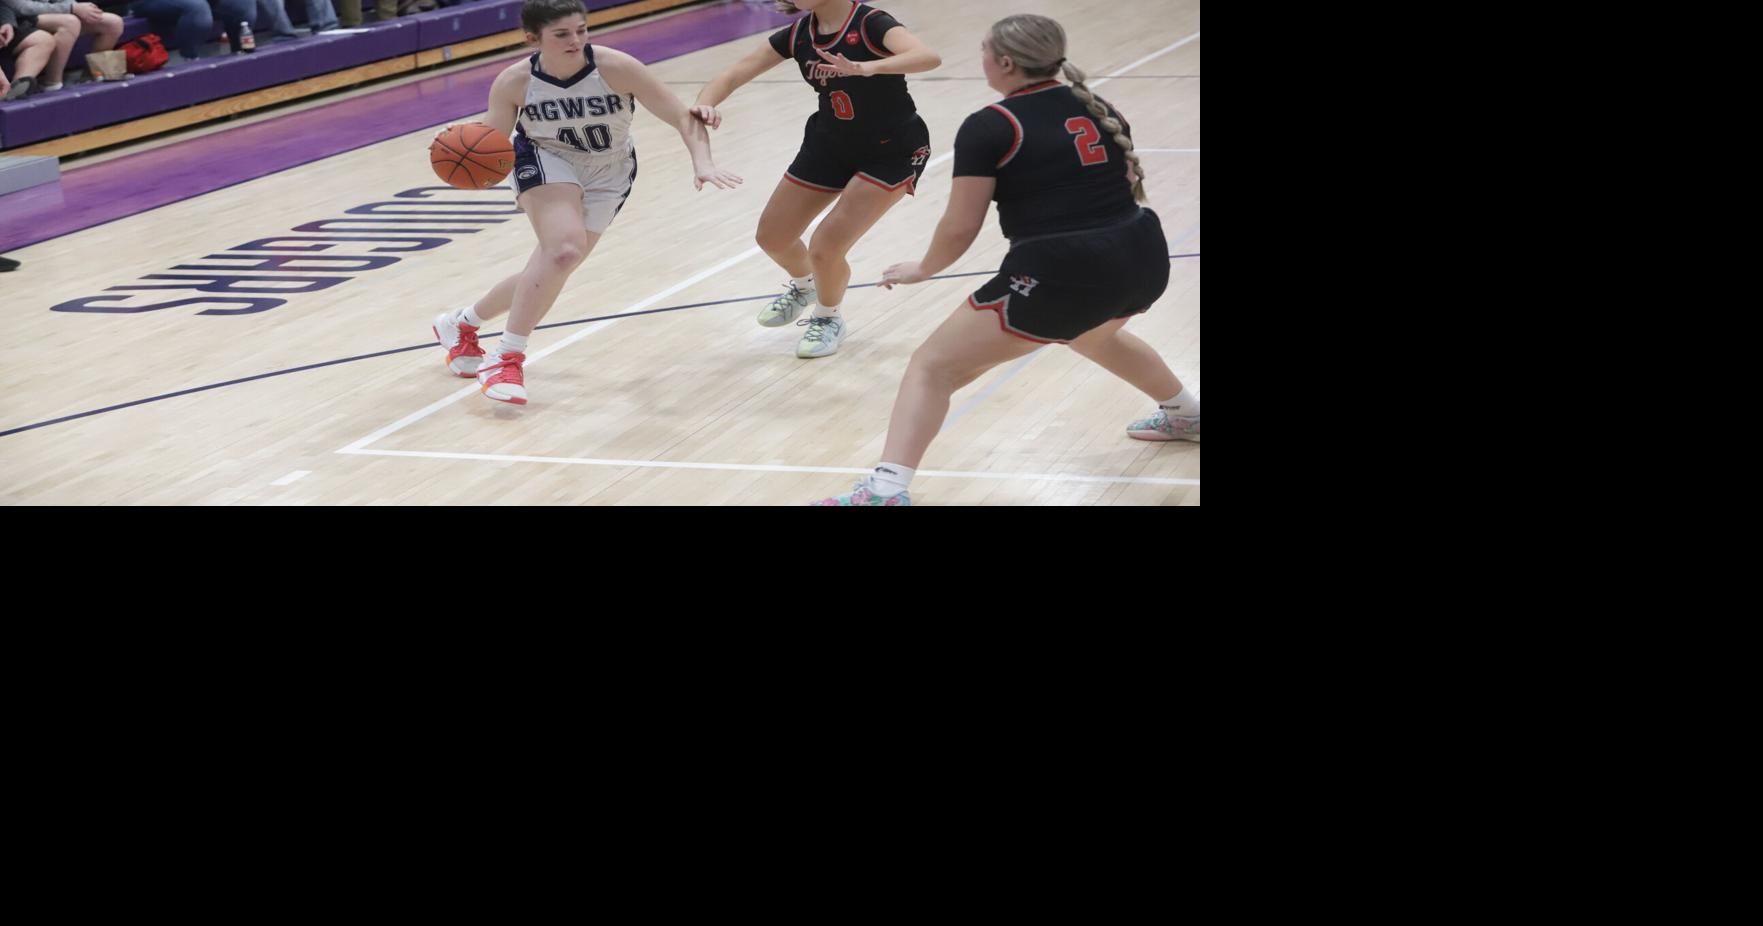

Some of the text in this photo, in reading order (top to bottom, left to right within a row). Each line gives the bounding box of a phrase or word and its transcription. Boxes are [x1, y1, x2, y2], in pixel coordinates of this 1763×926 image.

[524, 94, 623, 121] AGWSR
[829, 90, 854, 120] 0
[556, 123, 612, 153] 40
[1064, 116, 1108, 166] 2
